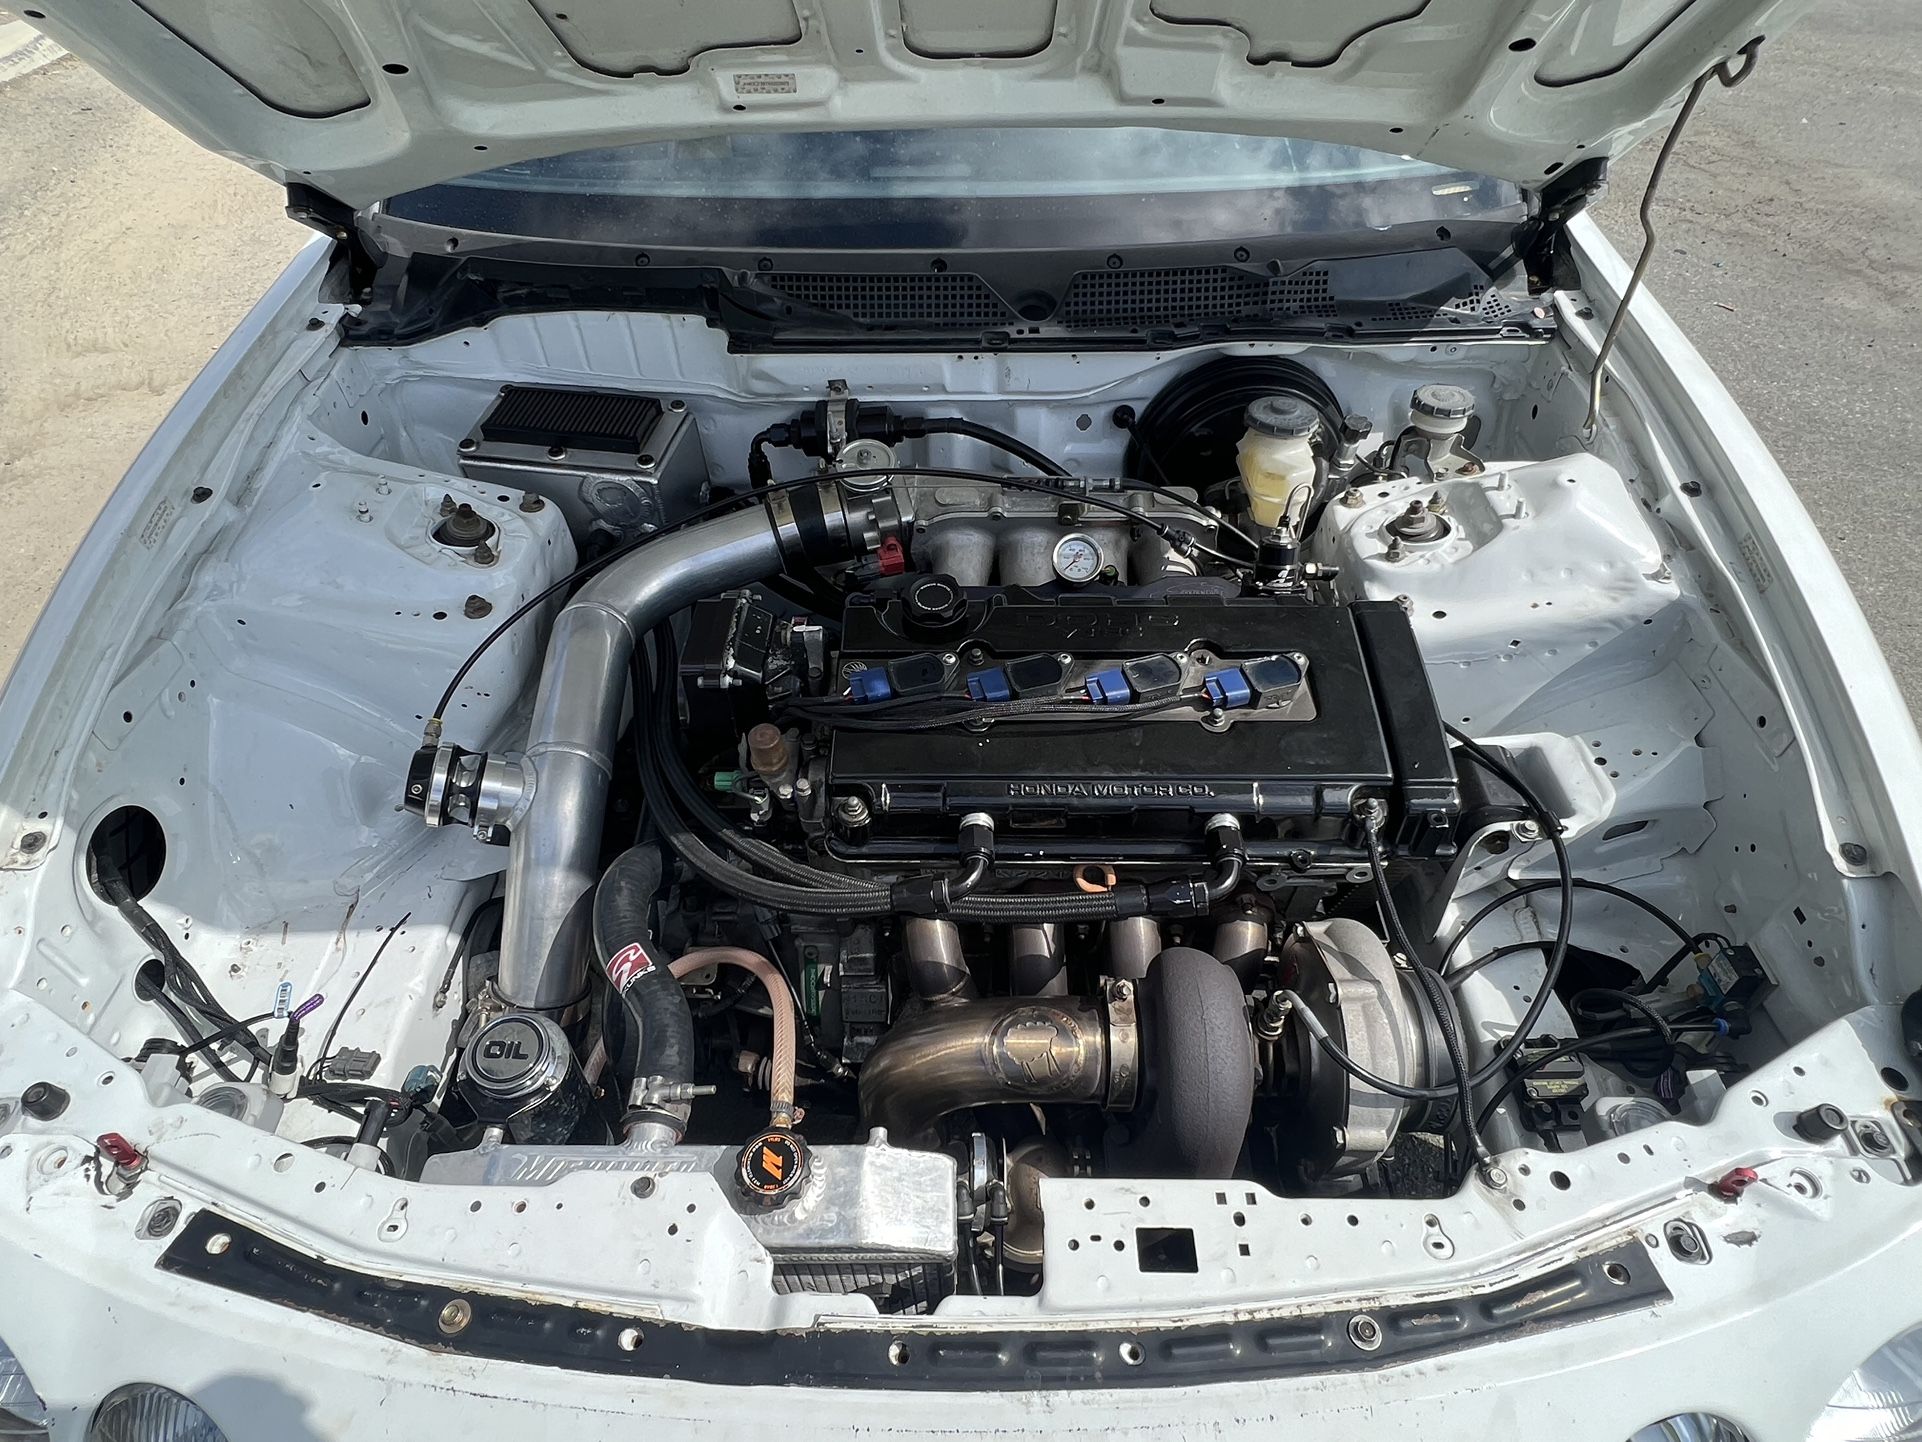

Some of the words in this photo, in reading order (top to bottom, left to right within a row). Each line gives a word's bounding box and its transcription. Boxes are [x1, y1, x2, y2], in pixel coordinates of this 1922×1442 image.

[1007, 782, 1089, 797] HONDA
[1091, 782, 1174, 797] MOTOR
[1176, 782, 1216, 797] CO.
[483, 1040, 529, 1060] OIL
